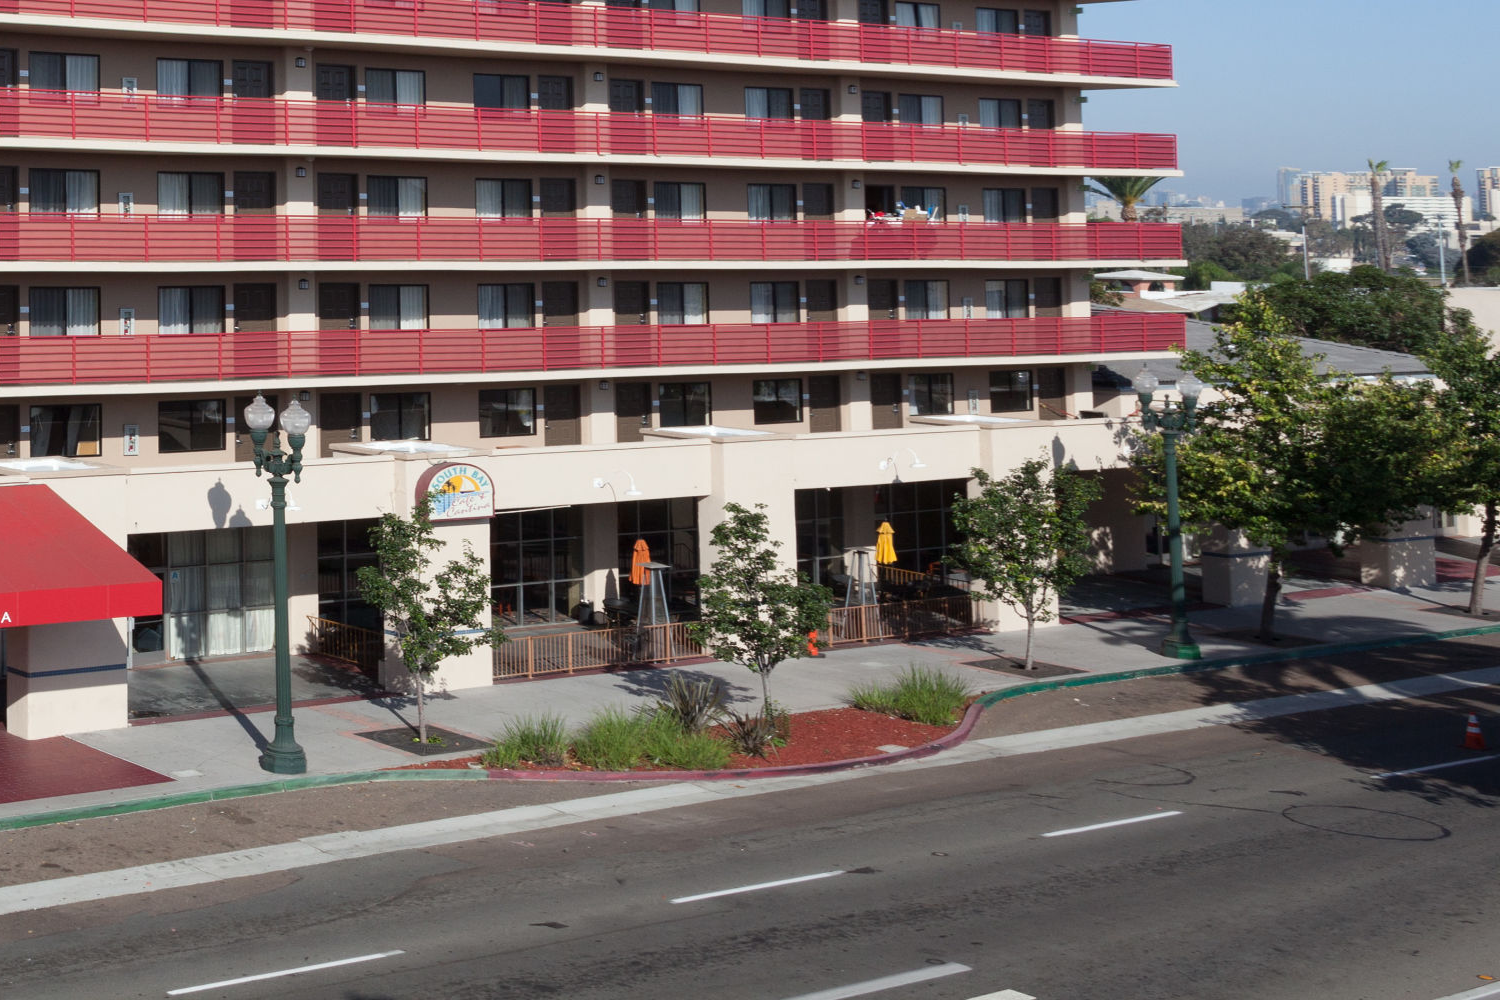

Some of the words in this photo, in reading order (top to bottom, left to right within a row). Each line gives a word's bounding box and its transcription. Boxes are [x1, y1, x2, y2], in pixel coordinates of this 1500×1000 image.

[431, 466, 467, 490] SOUTH
[471, 470, 489, 487] BAY
[446, 502, 491, 518] Cantina
